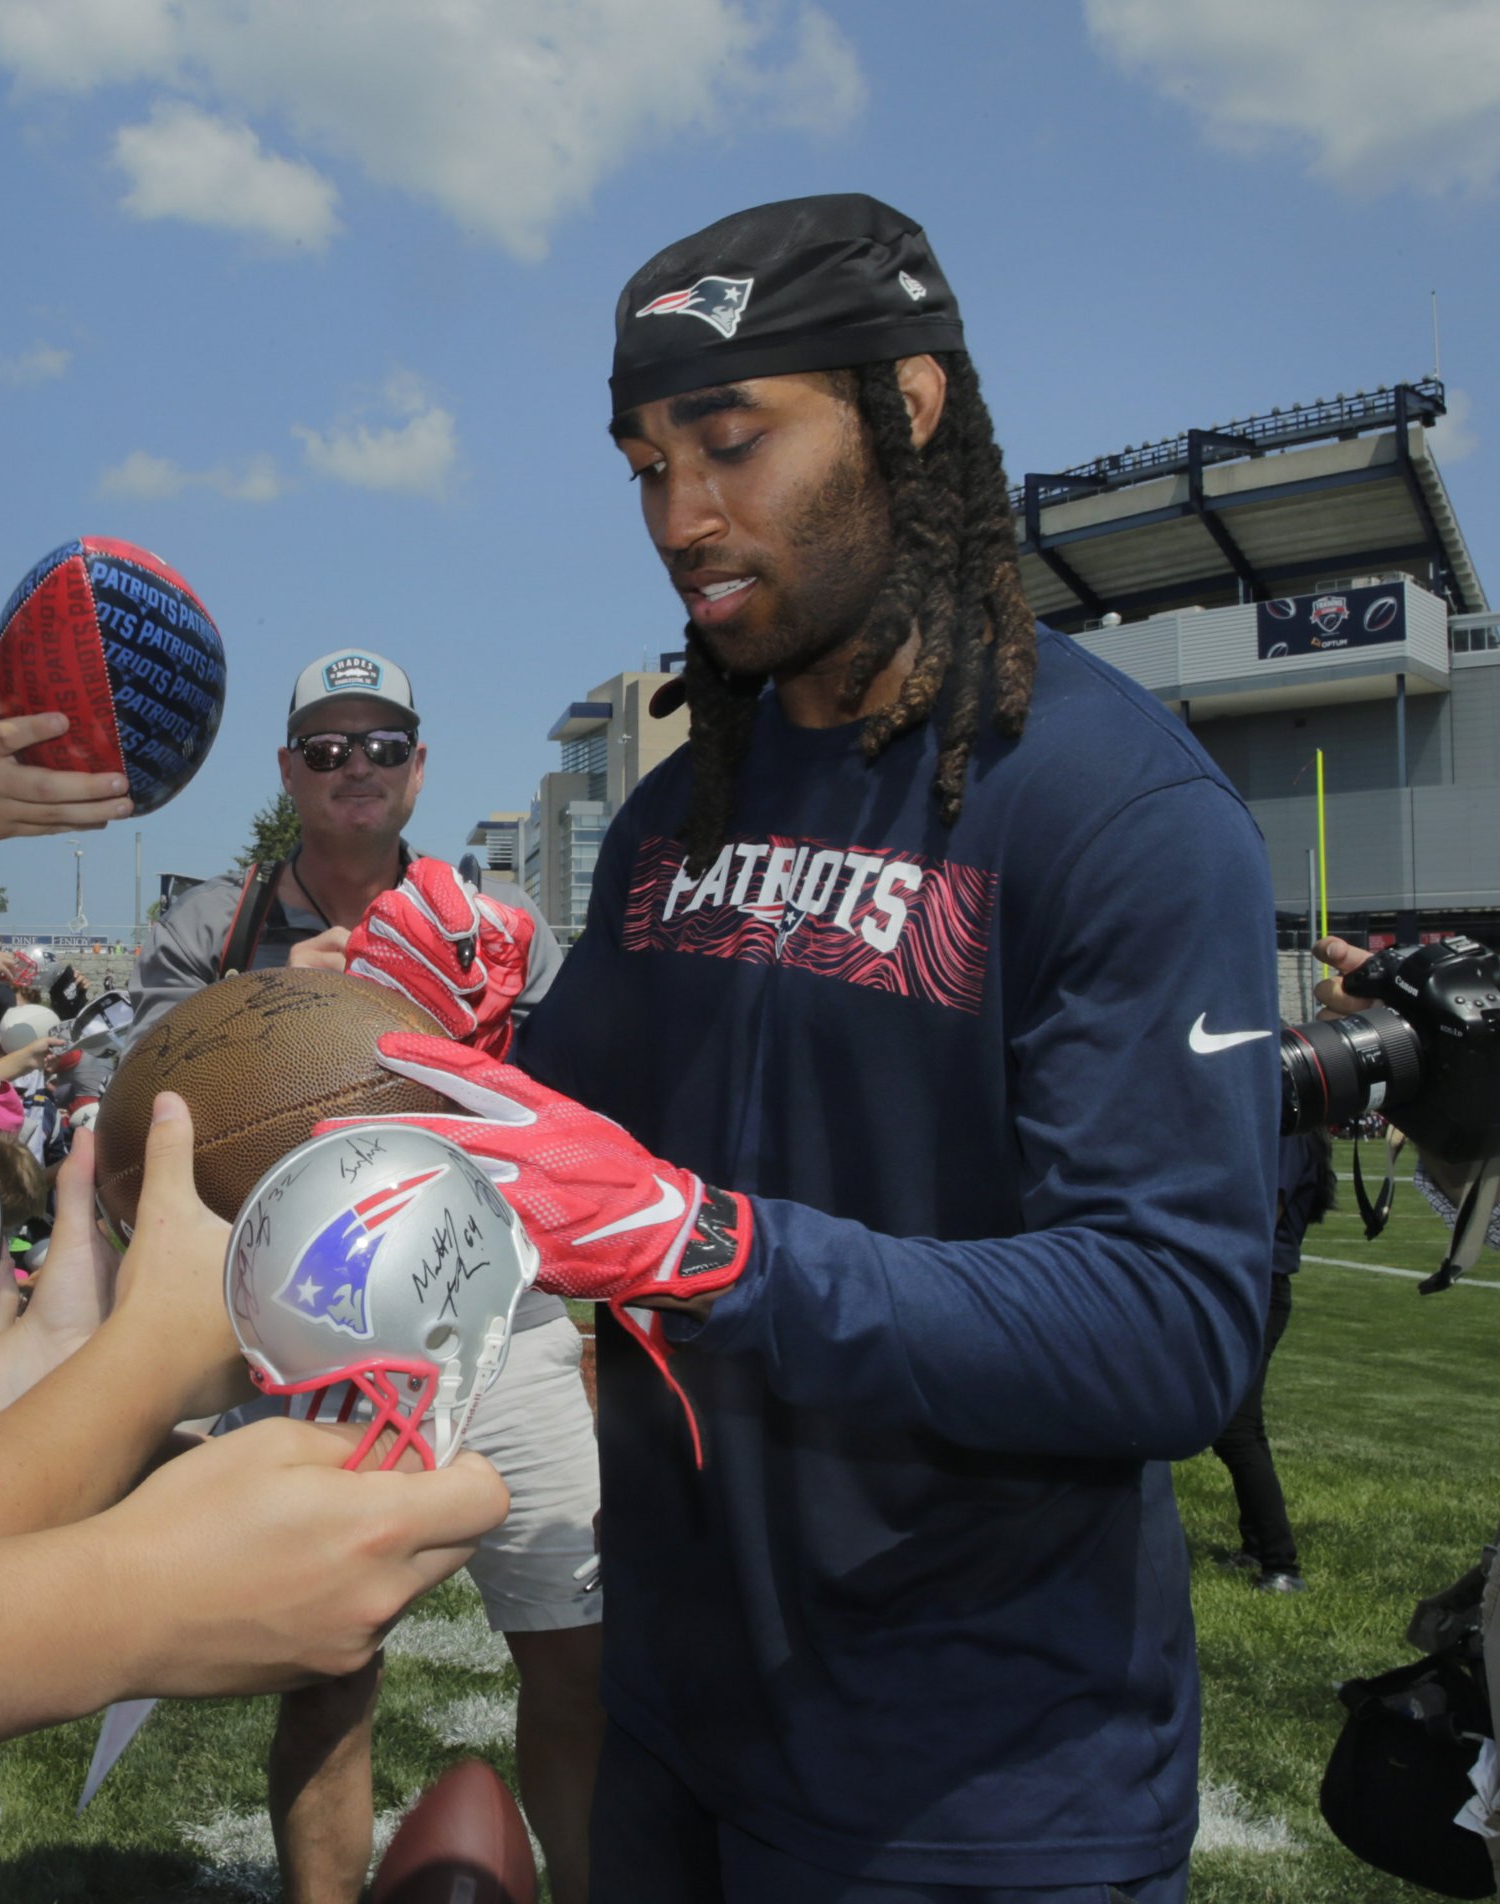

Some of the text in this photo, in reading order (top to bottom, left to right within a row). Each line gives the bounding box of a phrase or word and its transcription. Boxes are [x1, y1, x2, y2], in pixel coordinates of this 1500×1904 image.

[91, 561, 178, 626] PATRIOTS
[41, 577, 71, 684] PATRIOTS
[137, 620, 207, 679] PATRIOTS
[72, 622, 111, 720] PATRIOTS
[332, 658, 373, 672] SHADES
[112, 685, 192, 743] PATRIOTS
[59, 936, 90, 946] ENJOY
[1395, 975, 1419, 997] Canon
